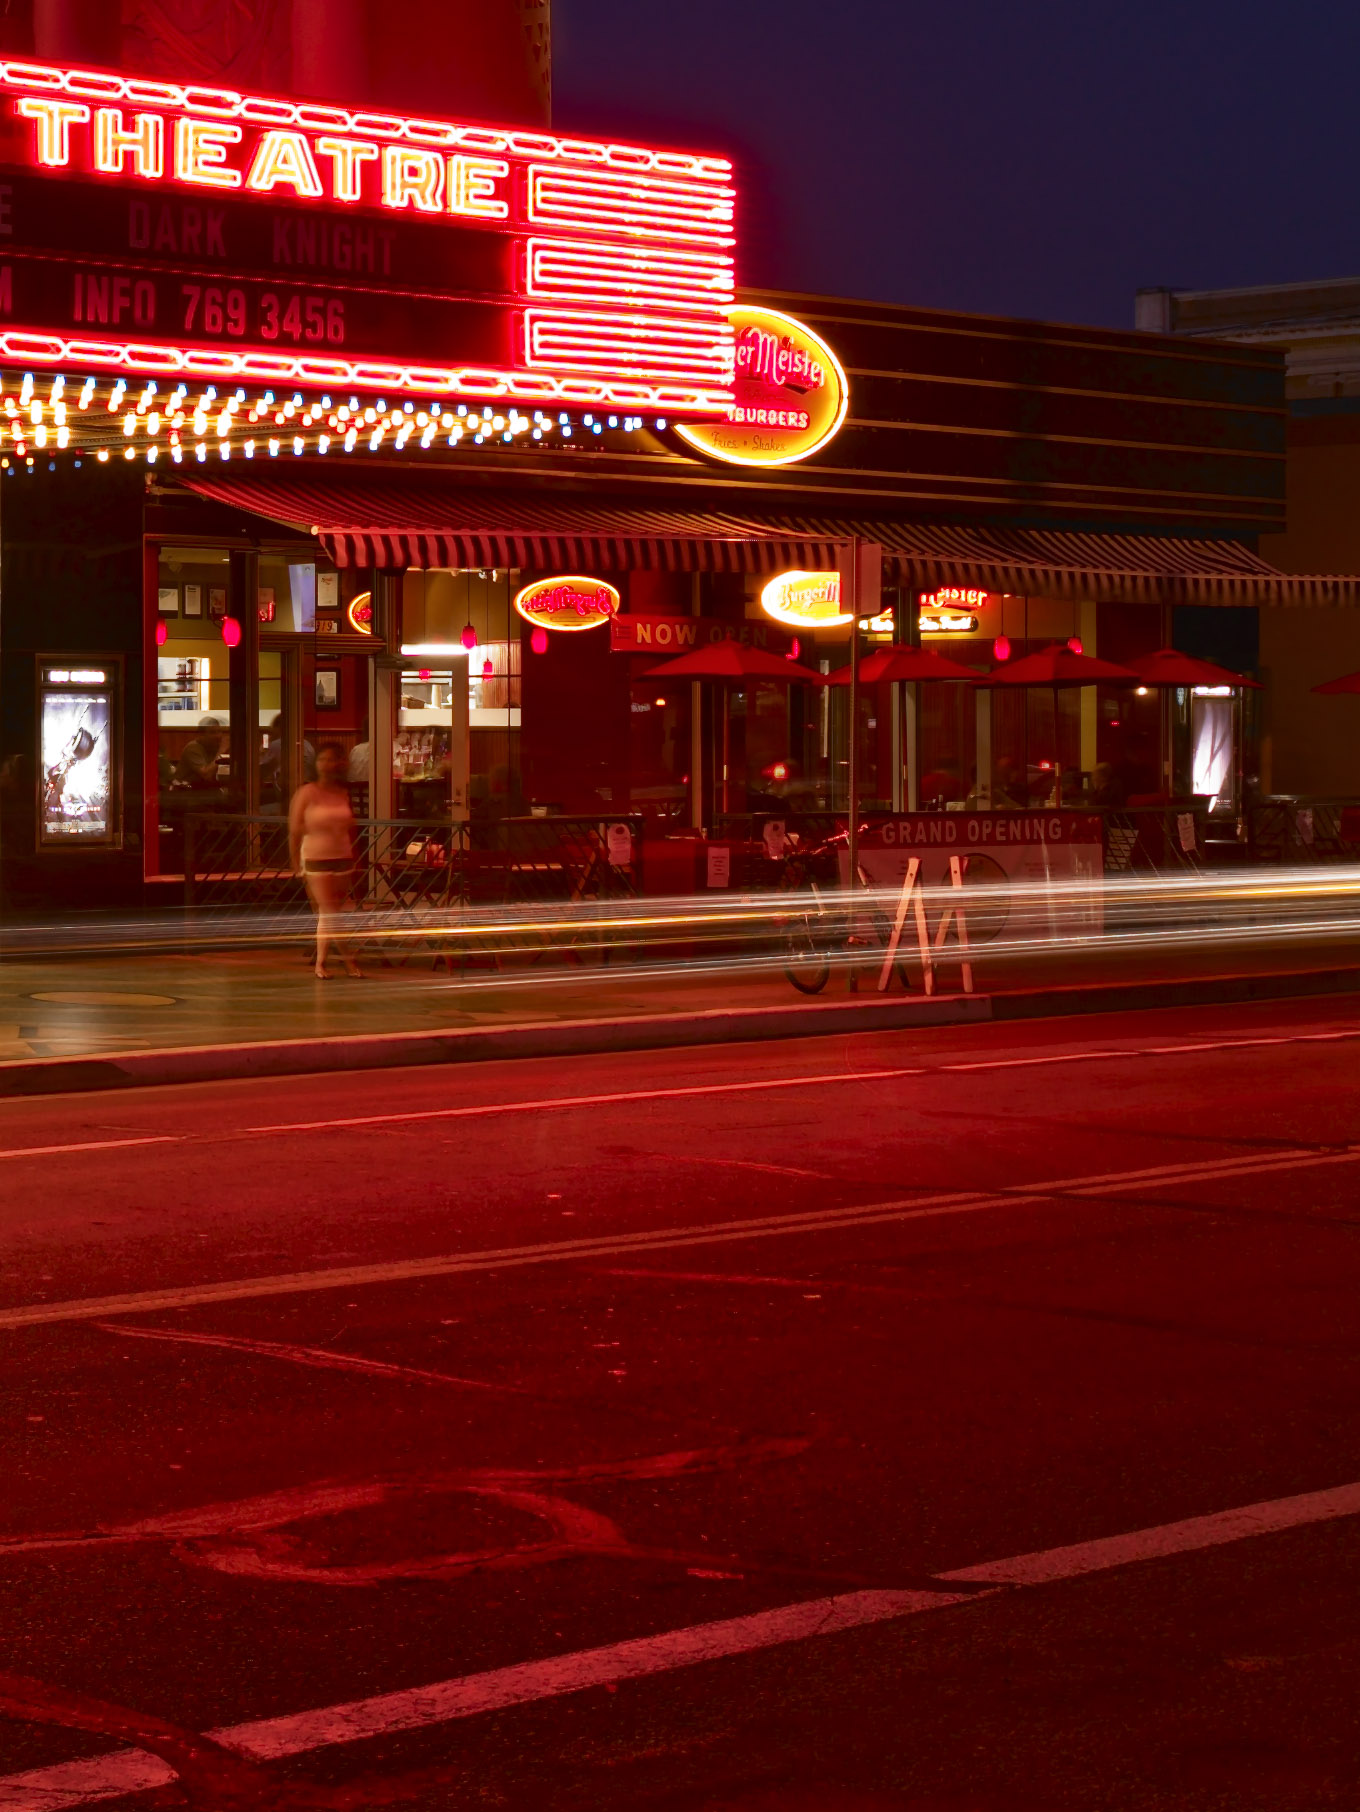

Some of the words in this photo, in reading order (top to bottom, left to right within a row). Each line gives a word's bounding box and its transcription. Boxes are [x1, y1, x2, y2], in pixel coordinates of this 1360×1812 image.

[17, 96, 509, 219] THEATRE
[129, 201, 226, 256] DARK
[273, 216, 397, 276] KNIGHT
[74, 275, 156, 327] INFO
[184, 285, 244, 337] 769
[261, 293, 345, 344] 3456
[727, 407, 810, 428] BURGERS
[636, 622, 696, 644] NOW
[882, 821, 956, 844] GRAND
[968, 818, 1061, 841] OPENING
